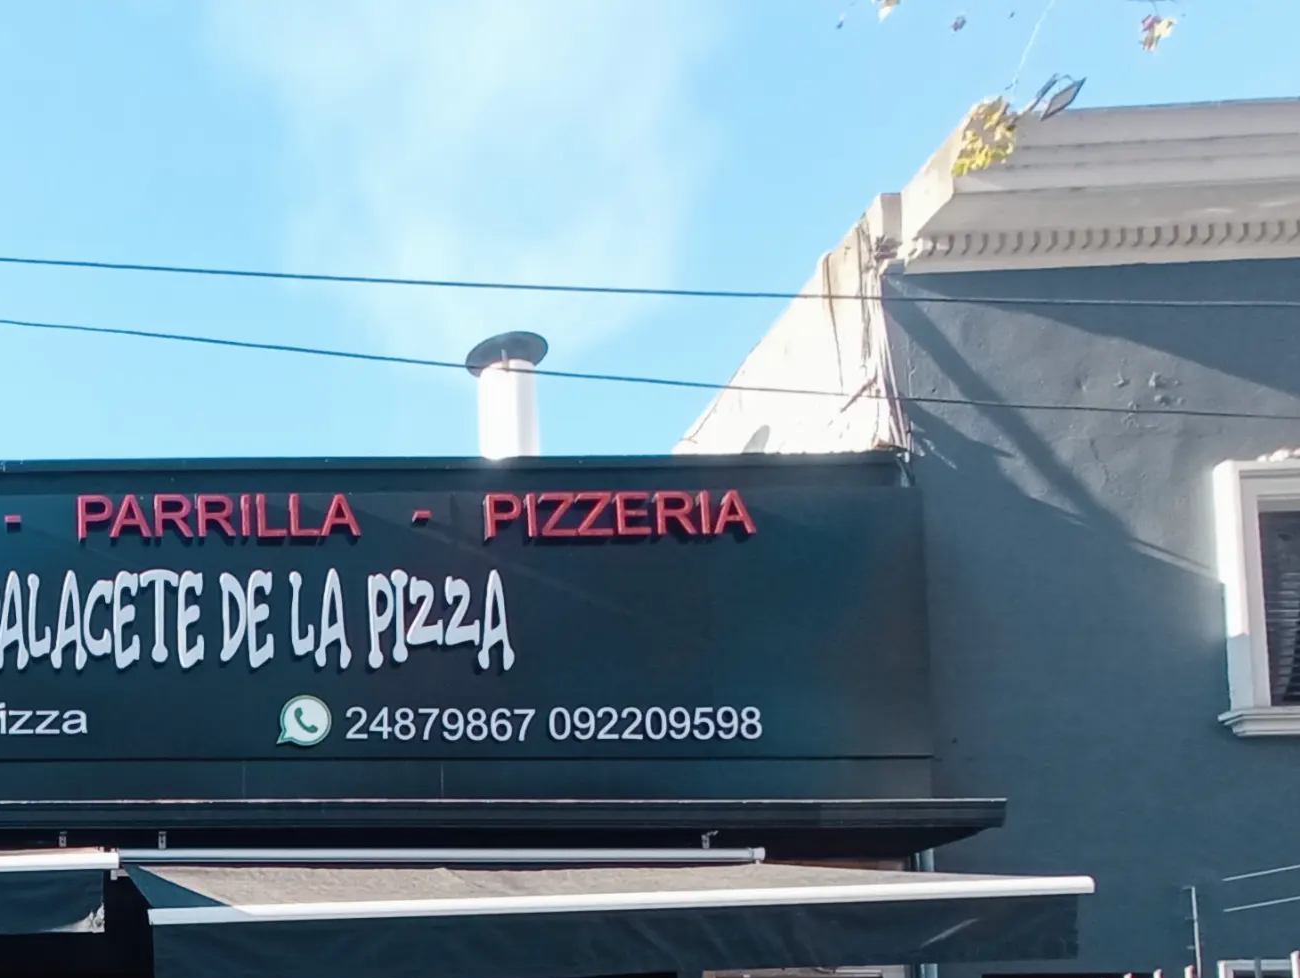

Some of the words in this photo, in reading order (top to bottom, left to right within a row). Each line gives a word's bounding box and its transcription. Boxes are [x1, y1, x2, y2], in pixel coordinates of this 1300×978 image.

[76, 492, 362, 541] PARRILLA
[483, 489, 757, 540] PIZZERIA
[219, 570, 274, 670] DE
[288, 567, 352, 670] LA
[367, 567, 516, 671] PIZZA
[345, 706, 536, 741] 24879867
[548, 706, 763, 741] 092209598
